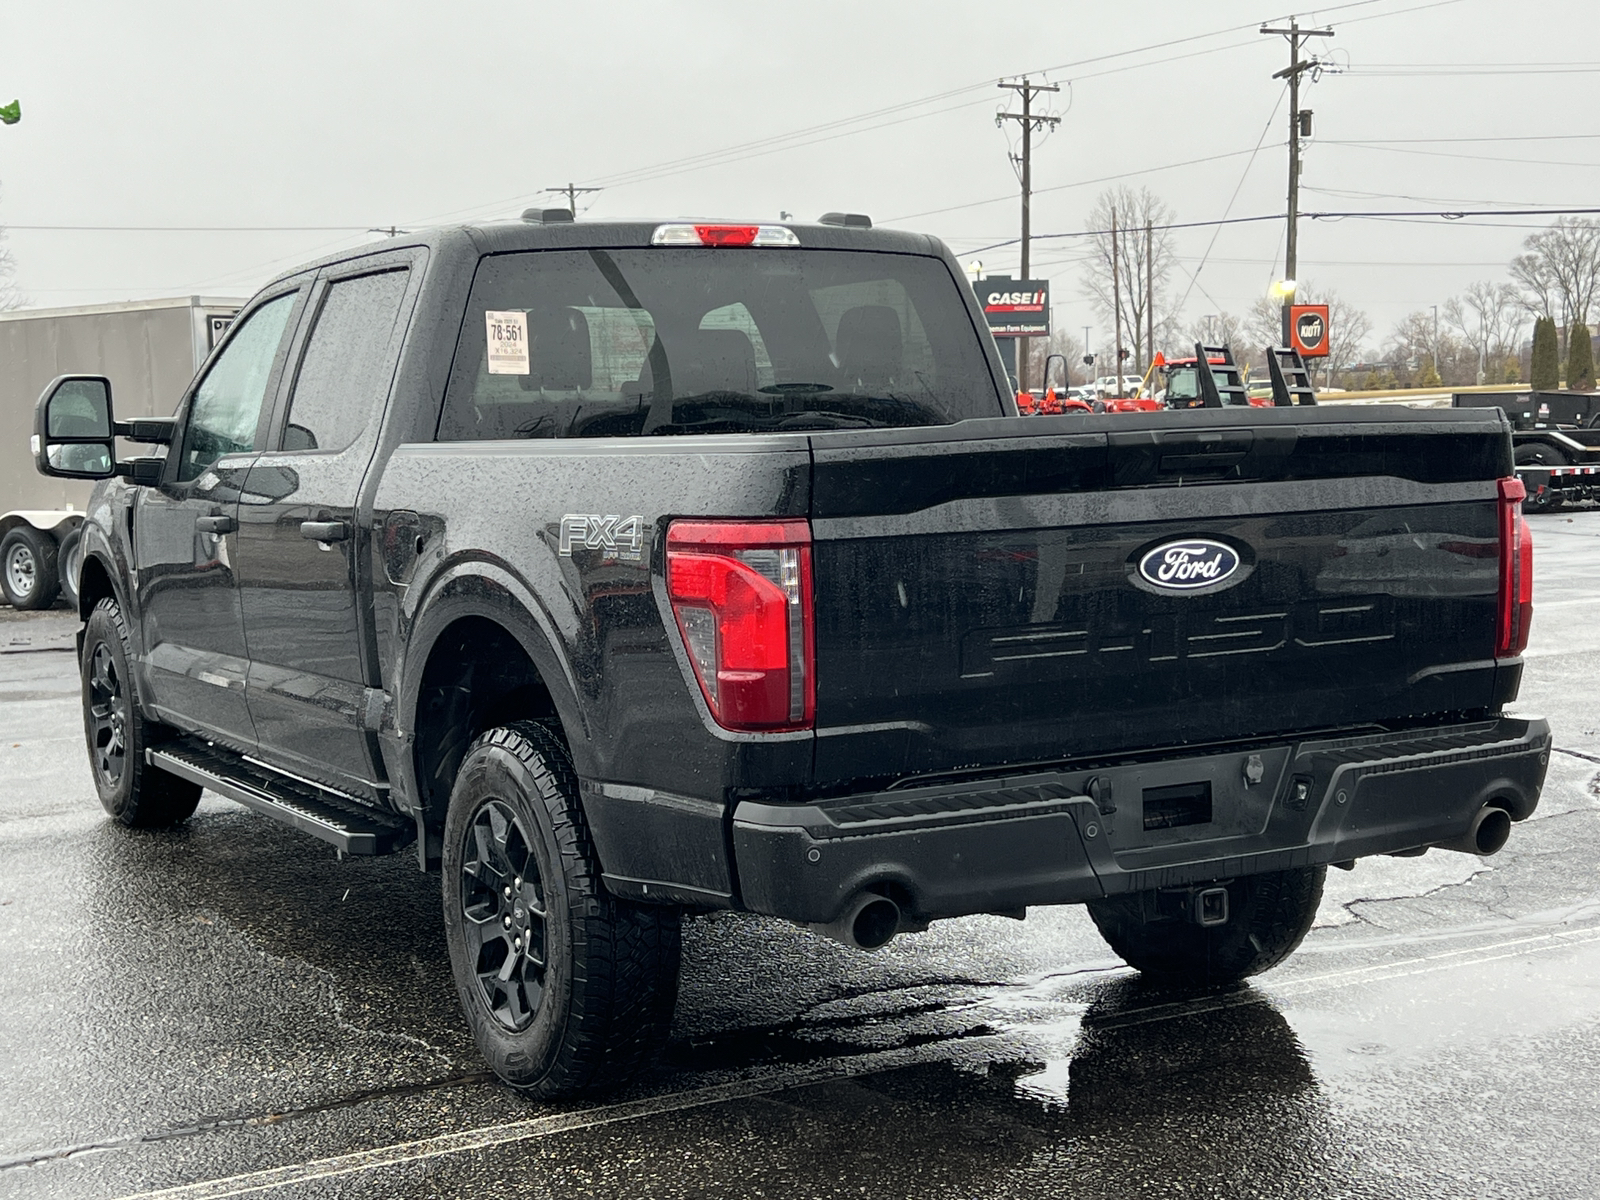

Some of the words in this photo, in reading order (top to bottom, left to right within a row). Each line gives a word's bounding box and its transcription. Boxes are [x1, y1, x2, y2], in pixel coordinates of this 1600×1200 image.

[987, 292, 1032, 304] CASE
[559, 513, 643, 556] FX4
[1158, 547, 1222, 581] Ford
